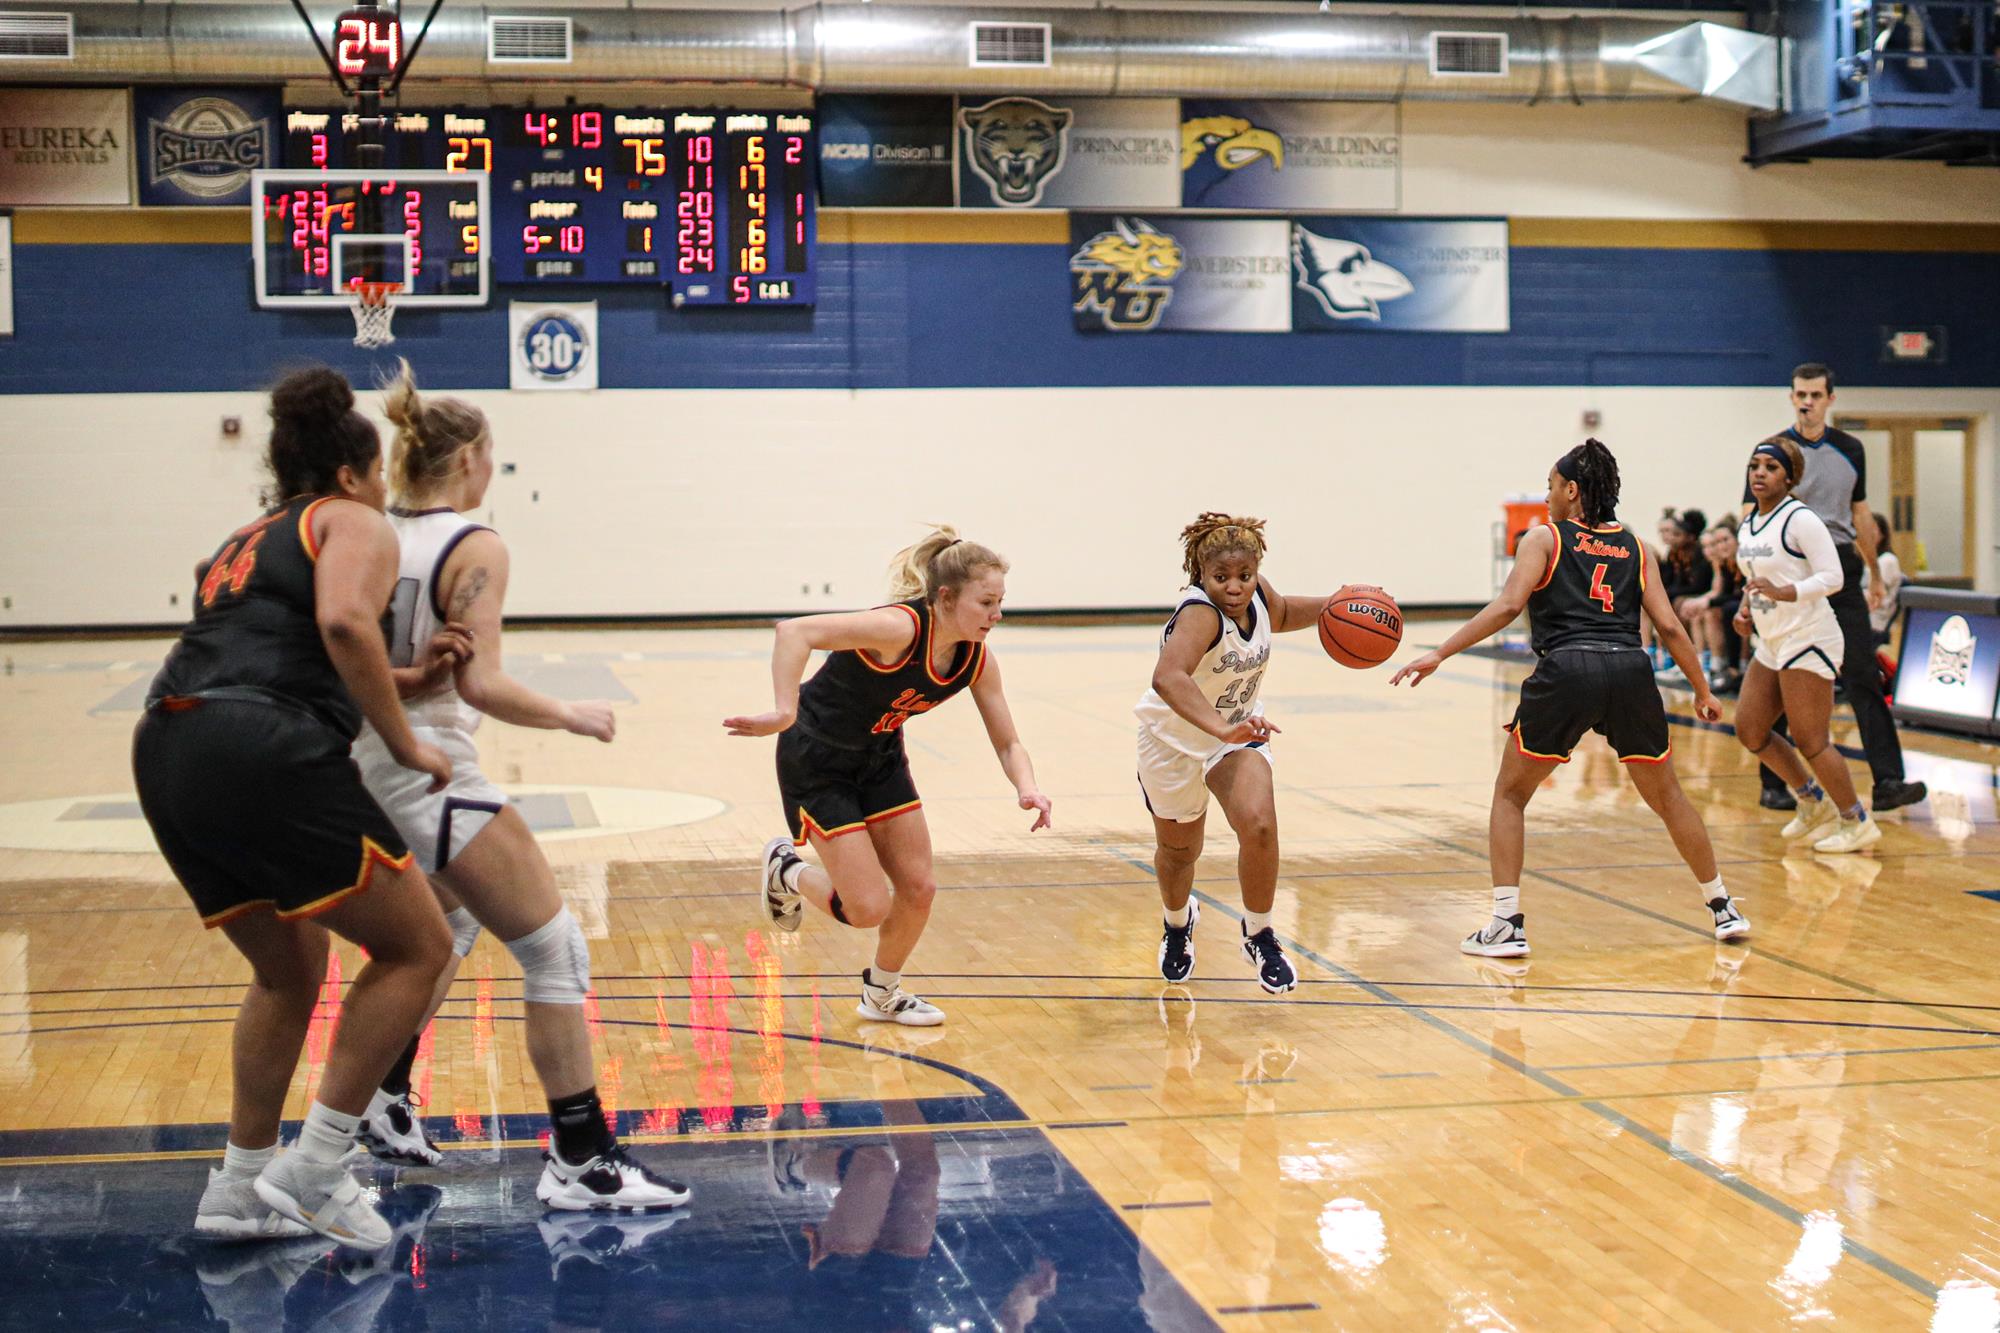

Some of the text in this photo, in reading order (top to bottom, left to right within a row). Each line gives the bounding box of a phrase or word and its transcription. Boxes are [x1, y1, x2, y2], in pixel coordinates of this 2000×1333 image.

[338, 19, 398, 73] 24
[1, 127, 120, 148] EUREKA
[524, 111, 602, 149] 4:19
[446, 137, 492, 174] 27
[622, 138, 666, 176] 75
[687, 136, 713, 163] 10
[747, 136, 765, 163] 6
[785, 137, 802, 164] 2
[1284, 136, 1398, 154] SPALDING
[531, 169, 575, 189] period
[585, 166, 602, 192] 4
[687, 165, 713, 189] 11
[740, 164, 765, 190] 17
[529, 200, 577, 220] player
[678, 191, 712, 219] 20
[747, 192, 766, 218] 4
[462, 226, 479, 254] 5
[644, 226, 652, 253] 1
[678, 218, 713, 246] 23
[748, 219, 766, 246] 6
[679, 246, 714, 273] 24
[741, 246, 766, 274] 16
[733, 276, 750, 303] 5
[531, 332, 574, 369] 30
[1573, 532, 1630, 558] Tritons
[200, 530, 266, 606] 44
[1589, 563, 1614, 613] 4
[1347, 601, 1400, 634] Wilson
